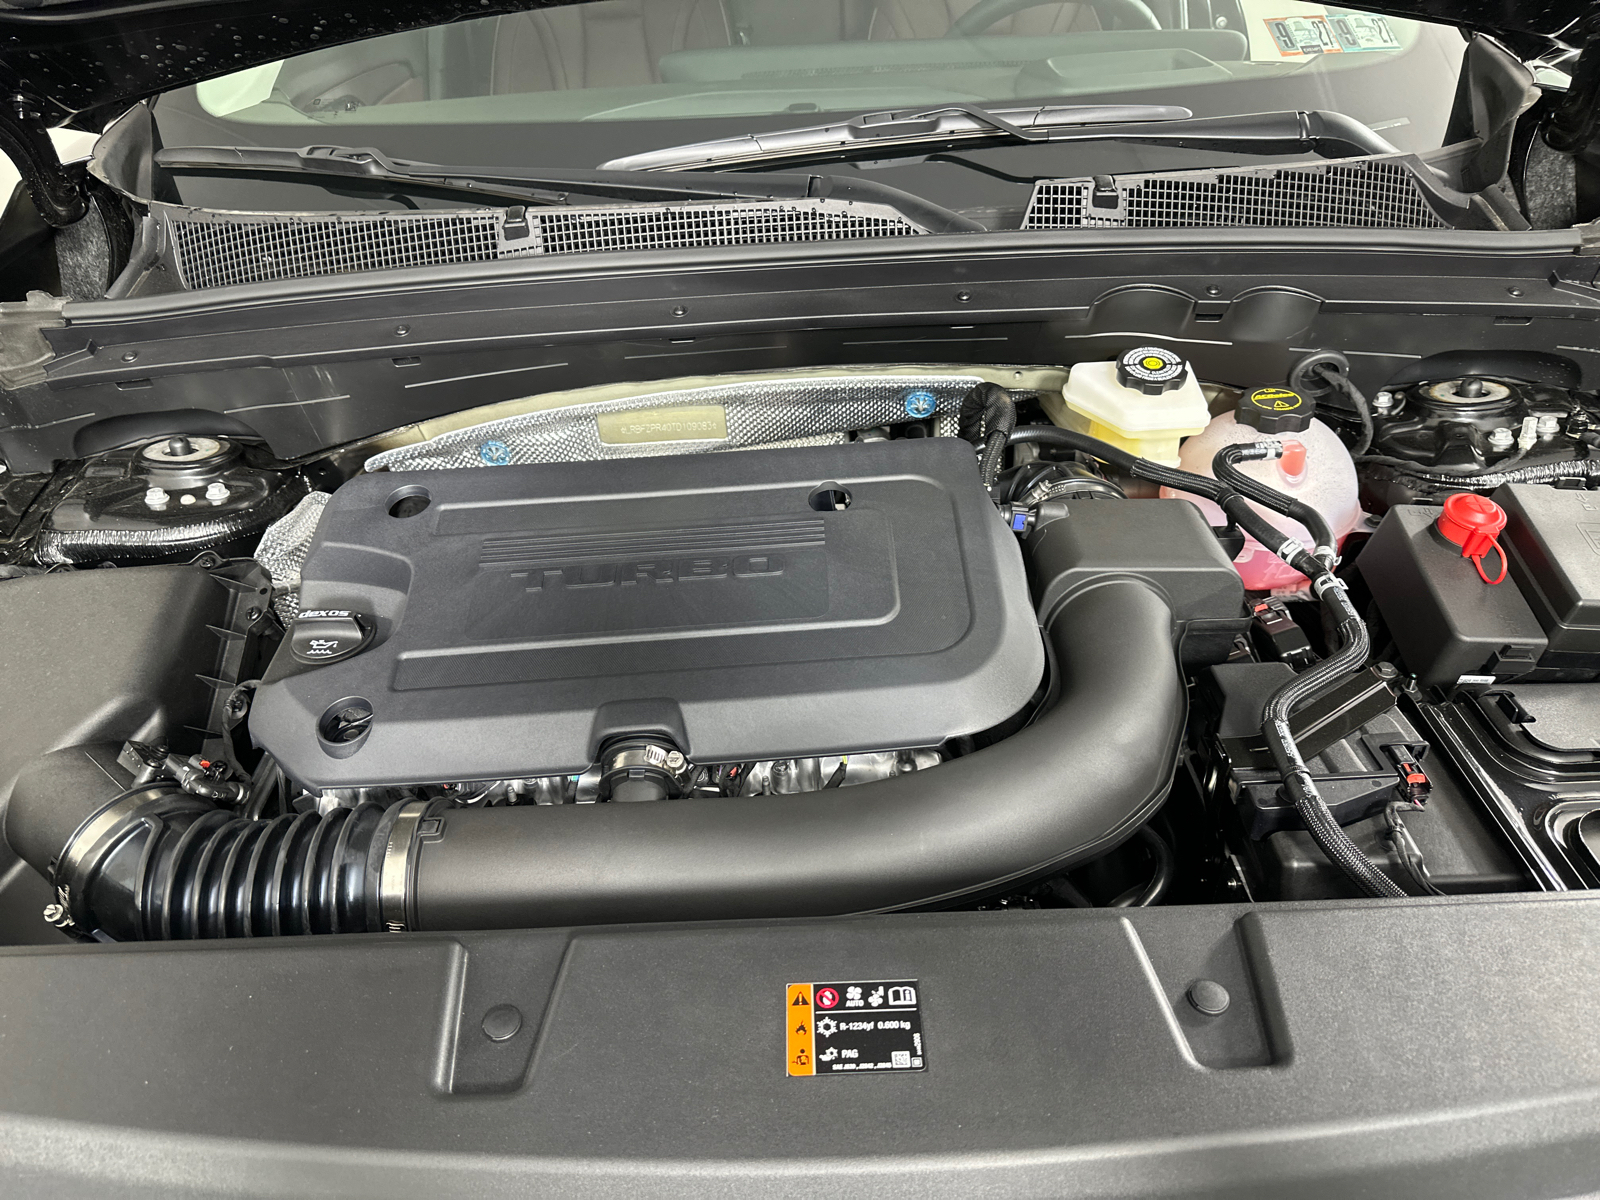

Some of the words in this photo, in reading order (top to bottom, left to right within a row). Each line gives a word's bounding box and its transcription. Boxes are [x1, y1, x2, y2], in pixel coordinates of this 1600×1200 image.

[1275, 22, 1295, 49] 9
[1311, 20, 1334, 48] 27
[1336, 19, 1357, 46] 9
[1371, 18, 1394, 44] 27
[510, 554, 786, 592] TURBO
[298, 610, 352, 618] dexos
[839, 1021, 874, 1032] R-1234yf
[900, 1020, 911, 1030] kg
[841, 1049, 859, 1058] PAG
